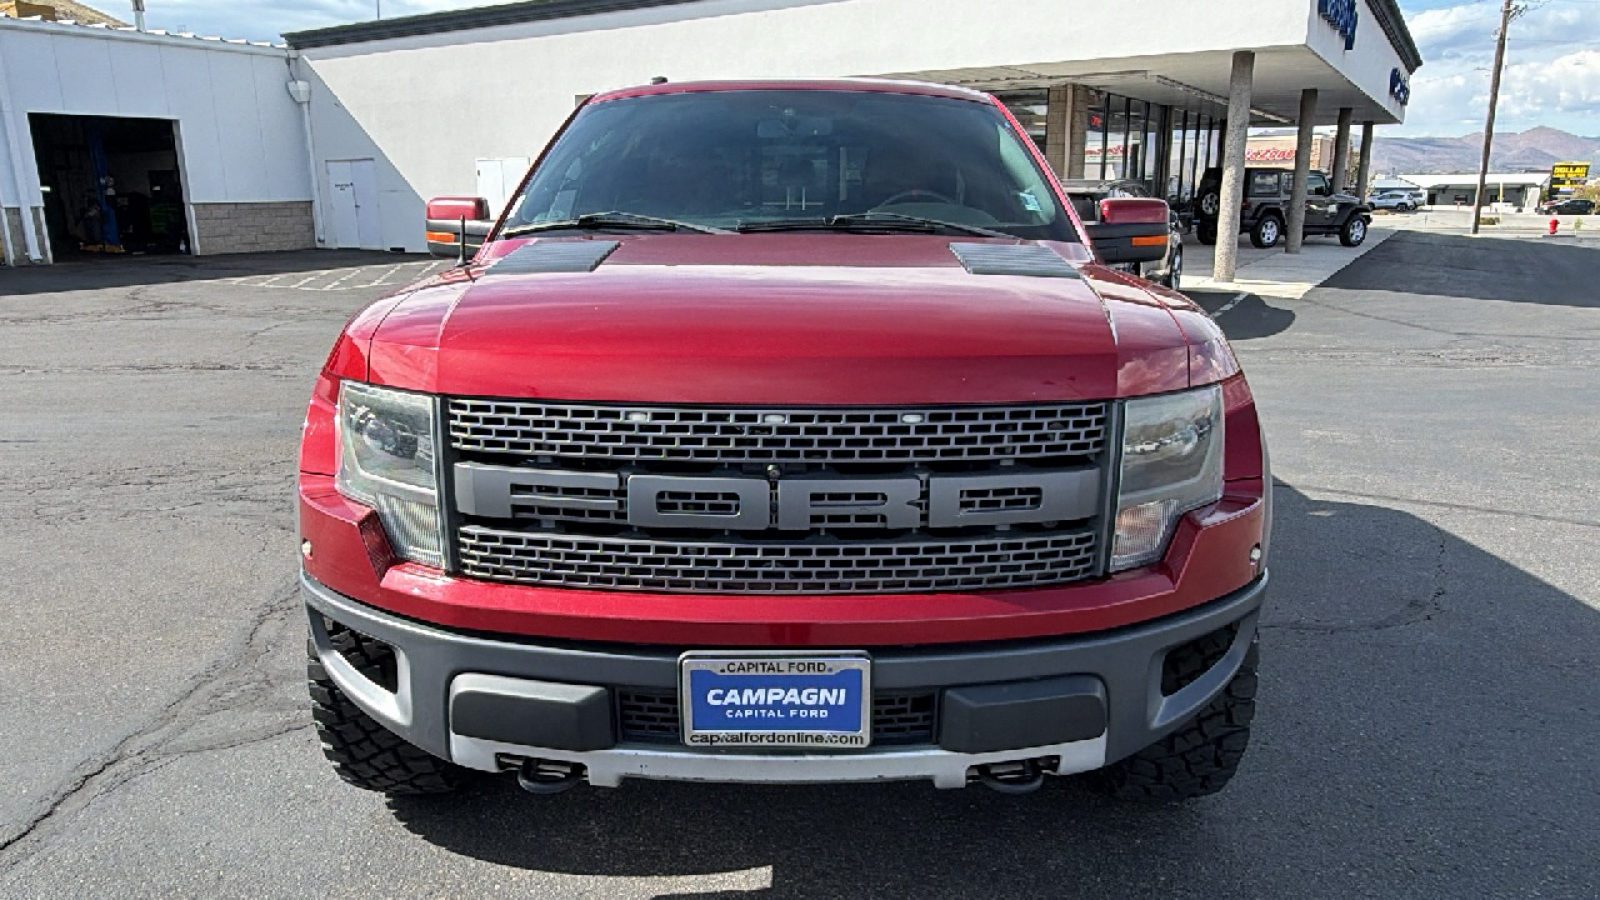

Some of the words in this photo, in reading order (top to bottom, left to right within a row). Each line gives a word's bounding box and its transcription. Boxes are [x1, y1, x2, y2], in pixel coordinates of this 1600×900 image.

[454, 461, 1103, 531] FORD
[727, 662, 784, 672] CAPITAL
[788, 662, 827, 672] FORD
[707, 688, 846, 706] CAMPAGNI
[725, 709, 785, 719] CAPITAL
[790, 709, 828, 719] FORD
